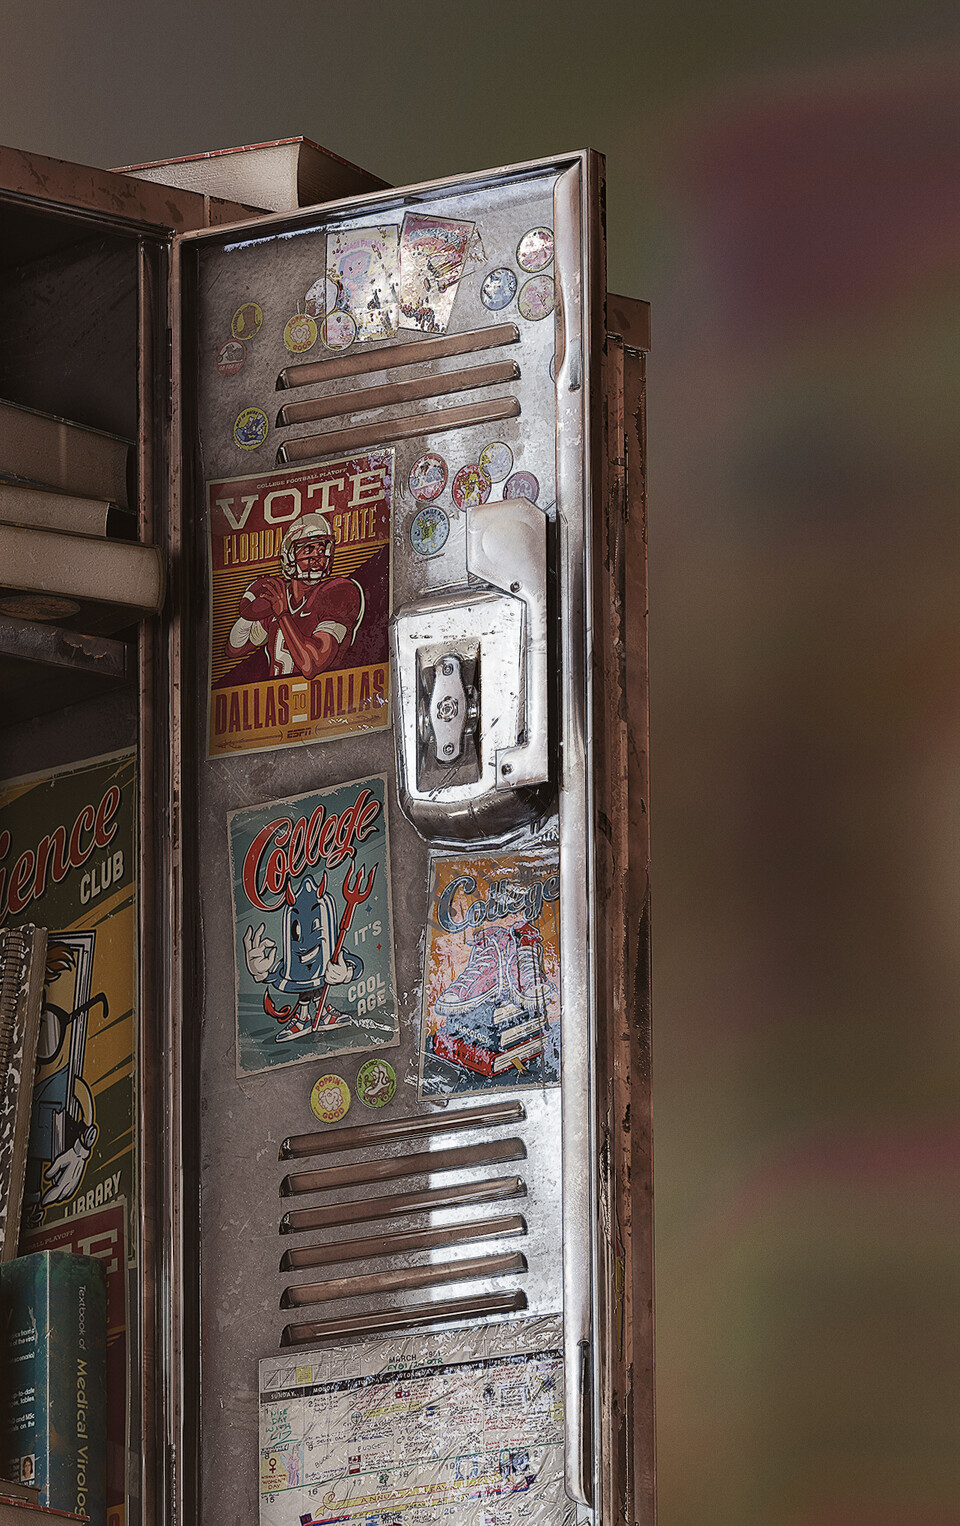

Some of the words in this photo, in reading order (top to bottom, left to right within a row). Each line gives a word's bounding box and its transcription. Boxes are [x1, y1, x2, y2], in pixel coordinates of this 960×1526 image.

[256, 479, 286, 490] COLLEGE
[286, 473, 319, 485] FOOTBALL
[319, 467, 348, 478] PLAYOFF
[215, 467, 387, 531] VOTE
[223, 526, 283, 565] FLORIDA
[332, 506, 377, 546] STATE
[215, 683, 290, 736] DALLAS
[292, 690, 307, 711] TO
[309, 667, 386, 722] DALLAS
[286, 727, 312, 739] ESPN
[242, 788, 384, 912] College
[79, 849, 125, 905] CLUB
[437, 872, 561, 934] College
[353, 919, 383, 947] IT'S
[347, 976, 387, 1004] COOL
[357, 988, 387, 1017] AGE
[315, 1076, 344, 1092] POPPIN'
[322, 1107, 345, 1120] GOOD
[64, 1169, 123, 1218] LIBRARY
[77, 1284, 88, 1335] Textbook
[77, 1338, 88, 1351] of
[75, 1358, 89, 1439] Medical
[270, 1390, 295, 1400] SUNDAY
[308, 1488, 318, 1497] 16
